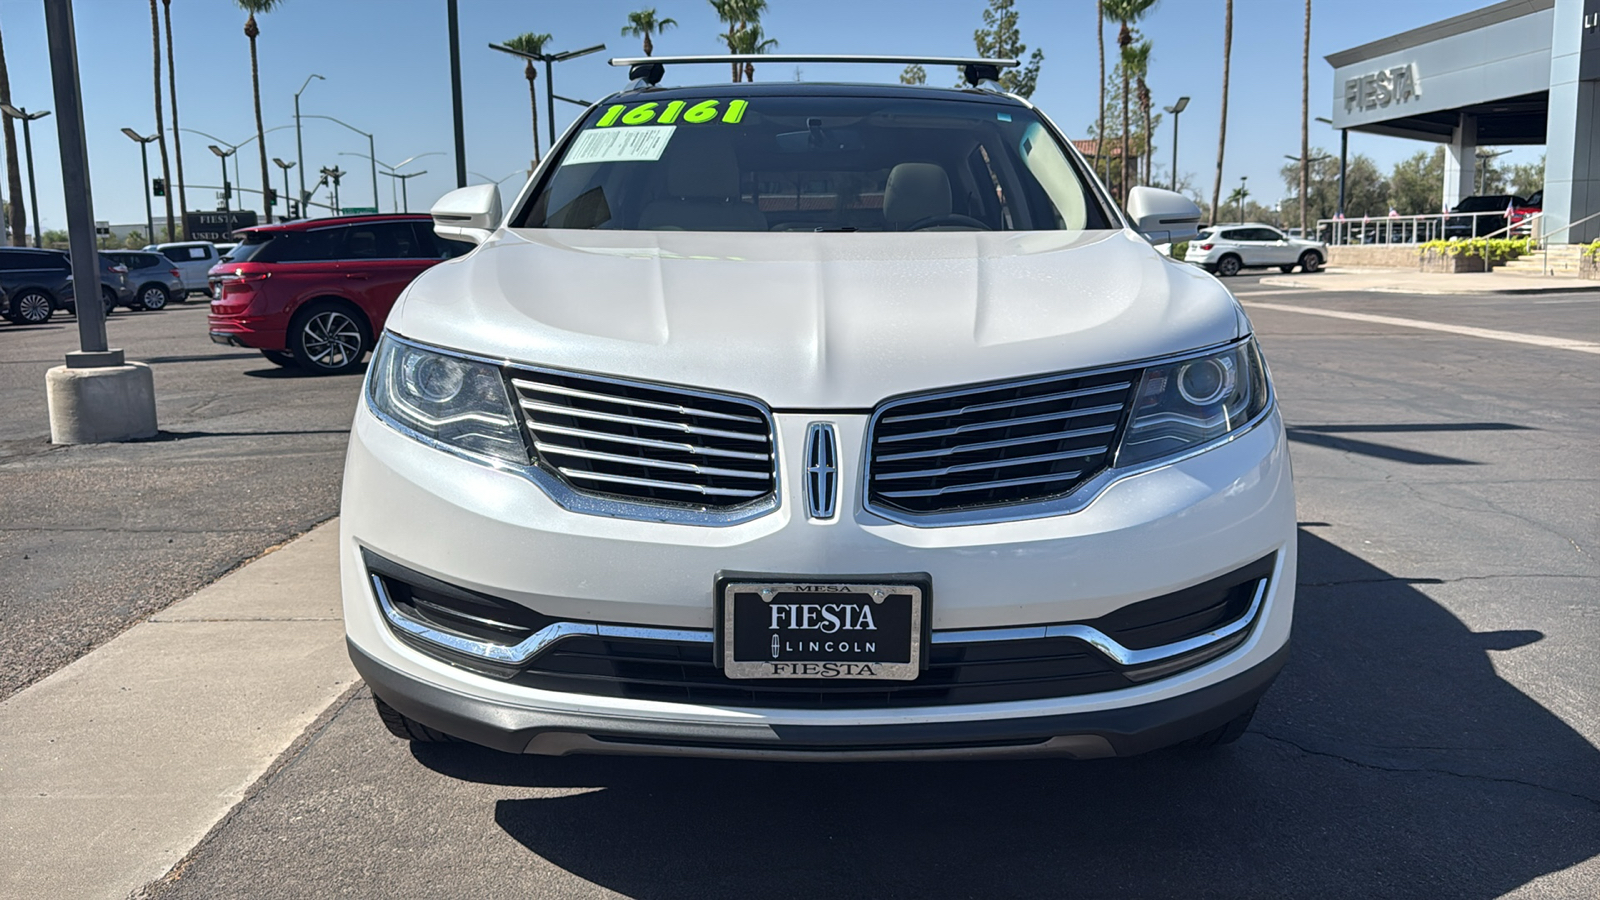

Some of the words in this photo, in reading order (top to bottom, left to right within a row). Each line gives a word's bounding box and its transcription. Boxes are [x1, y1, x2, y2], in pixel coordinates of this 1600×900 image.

[1344, 63, 1422, 114] FIESTA
[596, 99, 749, 128] 16161
[200, 215, 239, 224] FIESTA
[191, 232, 219, 240] USED
[768, 604, 878, 634] FIESTA
[786, 641, 876, 652] LINCOLN
[771, 662, 877, 678] FIESTA
